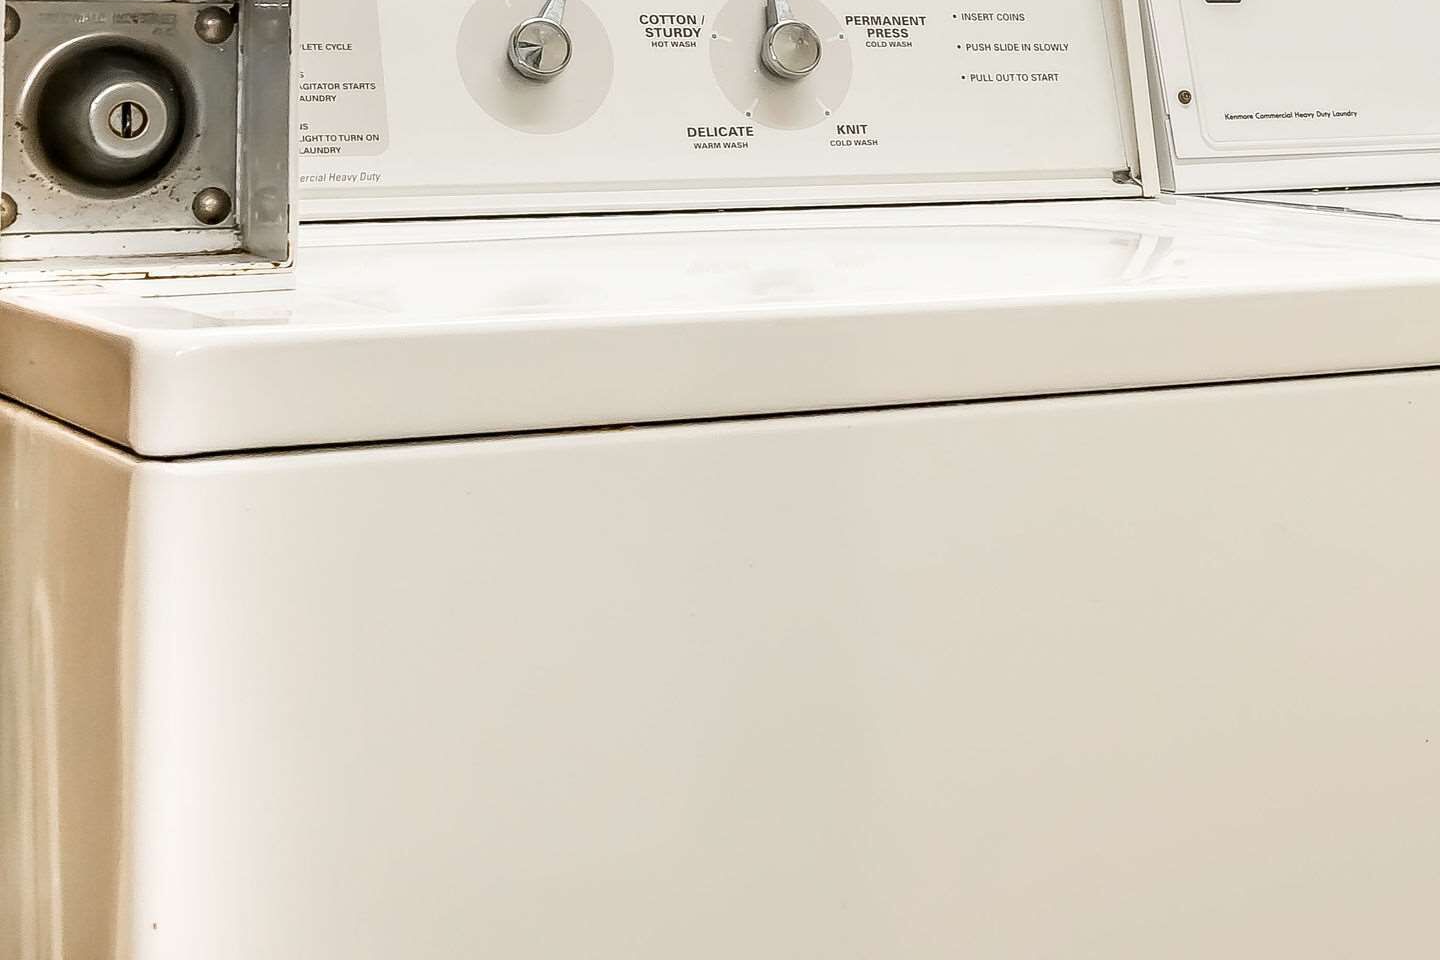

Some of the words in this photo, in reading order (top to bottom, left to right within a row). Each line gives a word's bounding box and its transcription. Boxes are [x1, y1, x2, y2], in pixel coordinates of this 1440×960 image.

[639, 14, 697, 25] COTTON
[845, 15, 927, 26] PERMANENT
[961, 12, 994, 22] INSERT
[996, 12, 1026, 22] COINS
[645, 27, 702, 38] STURDY
[866, 28, 909, 39] PRESS
[300, 43, 324, 51] LETE
[325, 43, 353, 51] CYCLE
[651, 40, 669, 48] HOT
[670, 40, 697, 48] WASH
[865, 40, 888, 48] COLD
[888, 40, 913, 48] WASH
[965, 42, 992, 52] PUSH
[993, 43, 1020, 52] SLIDE
[1021, 43, 1032, 52] IN
[1033, 43, 1069, 52] SLOWLY
[969, 73, 994, 82] PULL
[995, 73, 1016, 82] OUT
[1015, 73, 1029, 82] TO
[1030, 73, 1060, 82] START
[342, 82, 377, 90] STARTS
[1224, 111, 1254, 121] Kenmore
[1254, 111, 1294, 120] Commercial
[1294, 111, 1315, 119] Heavy
[1315, 110, 1331, 119] Duty
[1331, 109, 1358, 118] Laundry
[686, 126, 754, 138] DELICATE
[836, 124, 869, 135] KNIT
[324, 134, 338, 142] TO
[337, 134, 364, 142] TURN
[365, 133, 380, 142] ON
[693, 142, 722, 150] WARM
[722, 141, 749, 149] WASH
[829, 139, 853, 147] COLD
[853, 139, 879, 147] WASH
[328, 172, 359, 183] Heavy
[359, 171, 382, 183] Duty
